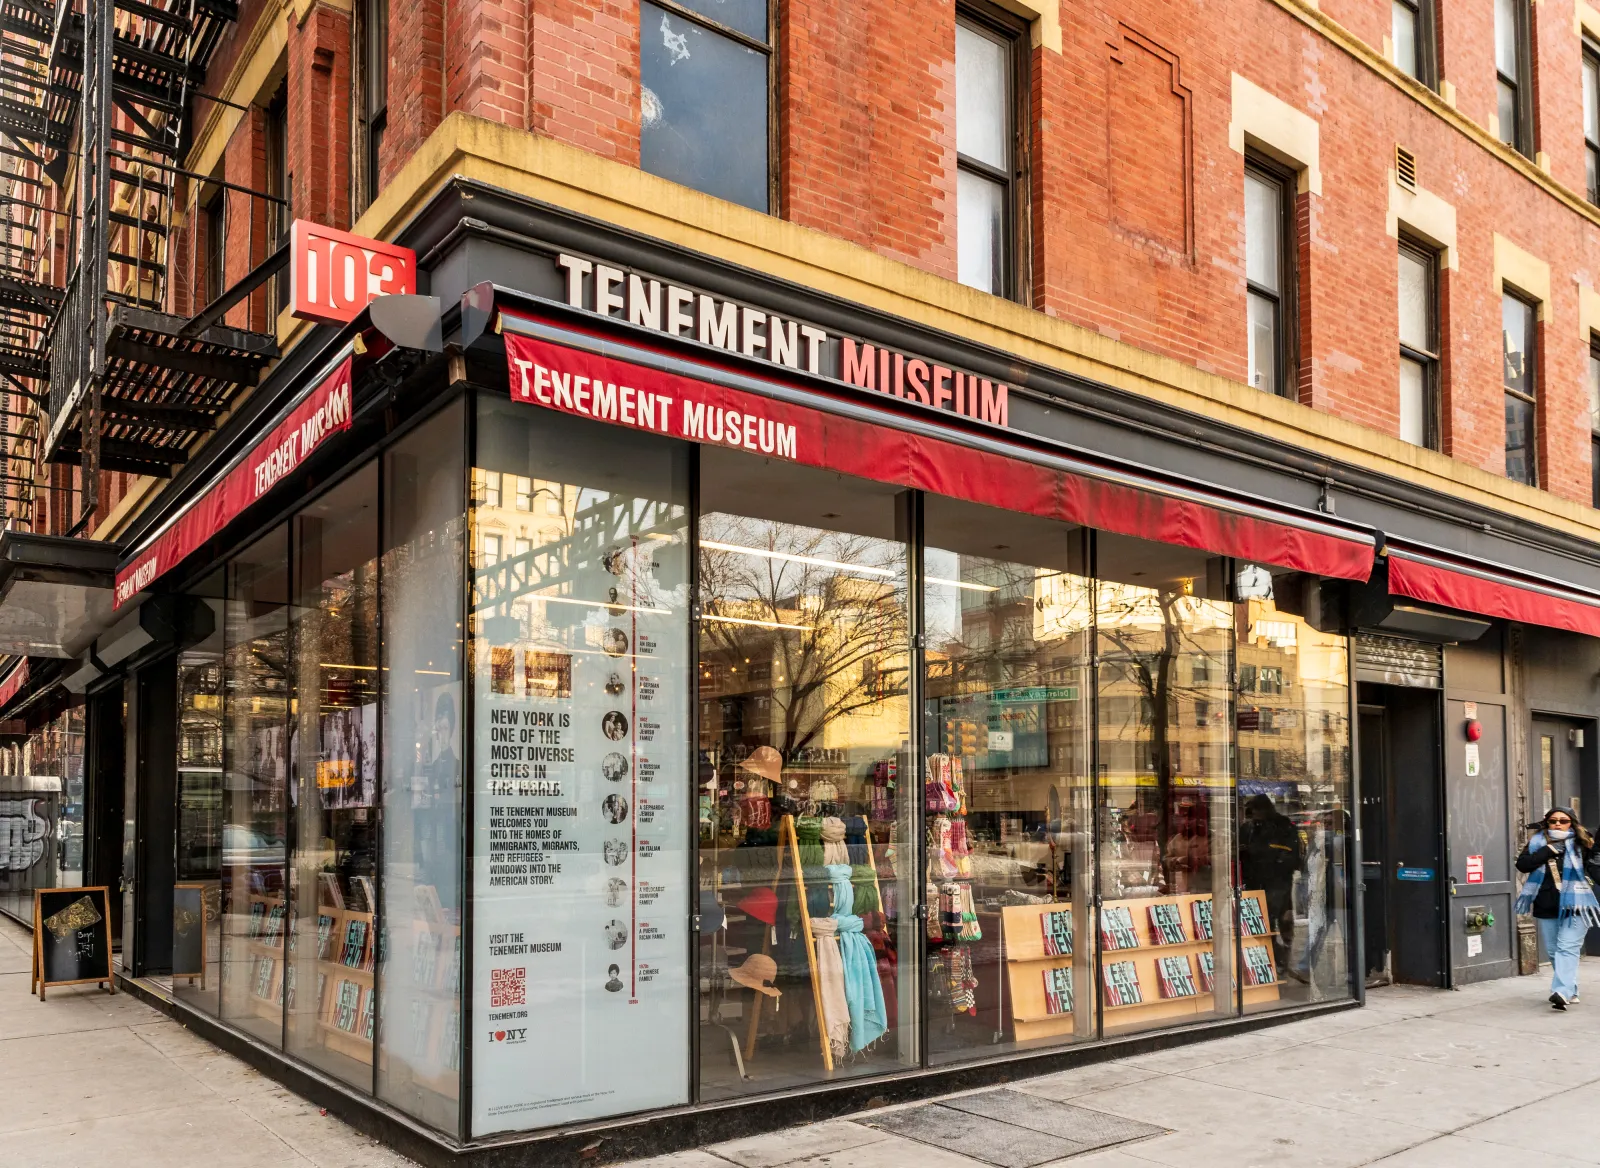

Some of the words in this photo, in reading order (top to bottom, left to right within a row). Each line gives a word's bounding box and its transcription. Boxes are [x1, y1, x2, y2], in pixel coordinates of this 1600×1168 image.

[307, 236, 406, 309] 103
[556, 253, 826, 374] TENEMENT
[840, 337, 1008, 427] MUSEUM
[514, 357, 672, 431] TENEMENT
[683, 399, 797, 459] MUSEUM
[491, 709, 518, 725] NEW
[523, 711, 554, 727] YORK
[559, 713, 570, 727] IS
[491, 728, 515, 743] ONE
[520, 729, 535, 743] OF
[538, 730, 560, 744] THE
[491, 746, 523, 761] MOST
[528, 747, 574, 763] DIVERSE
[491, 763, 530, 778] CITIES
[534, 765, 546, 778] IN
[490, 807, 504, 816] THE
[506, 807, 544, 817] TENEMENT
[547, 807, 577, 817] MUSEUM
[490, 819, 531, 828] WELCOMES
[534, 818, 548, 828] YOU
[490, 830, 507, 839] INTO
[510, 830, 523, 839] THE
[526, 830, 551, 839] HOMES
[553, 830, 562, 839] OF
[490, 841, 539, 852] IMMIGRANTS,
[542, 841, 580, 851] MIGRANTS,
[490, 853, 505, 862] AND
[507, 853, 544, 862] REFUGEES
[490, 864, 528, 874] WINDOWS
[530, 864, 546, 873] INTO
[548, 864, 561, 873] THE
[490, 876, 528, 886] AMERICAN
[530, 876, 554, 886] STORY.
[489, 934, 507, 944] VISIT
[510, 933, 524, 943] THE
[489, 945, 528, 956] TENEMENT
[530, 942, 562, 953] MUSEUM
[489, 1011, 528, 1021] TENEMENT.ORG
[489, 1032, 494, 1042] I
